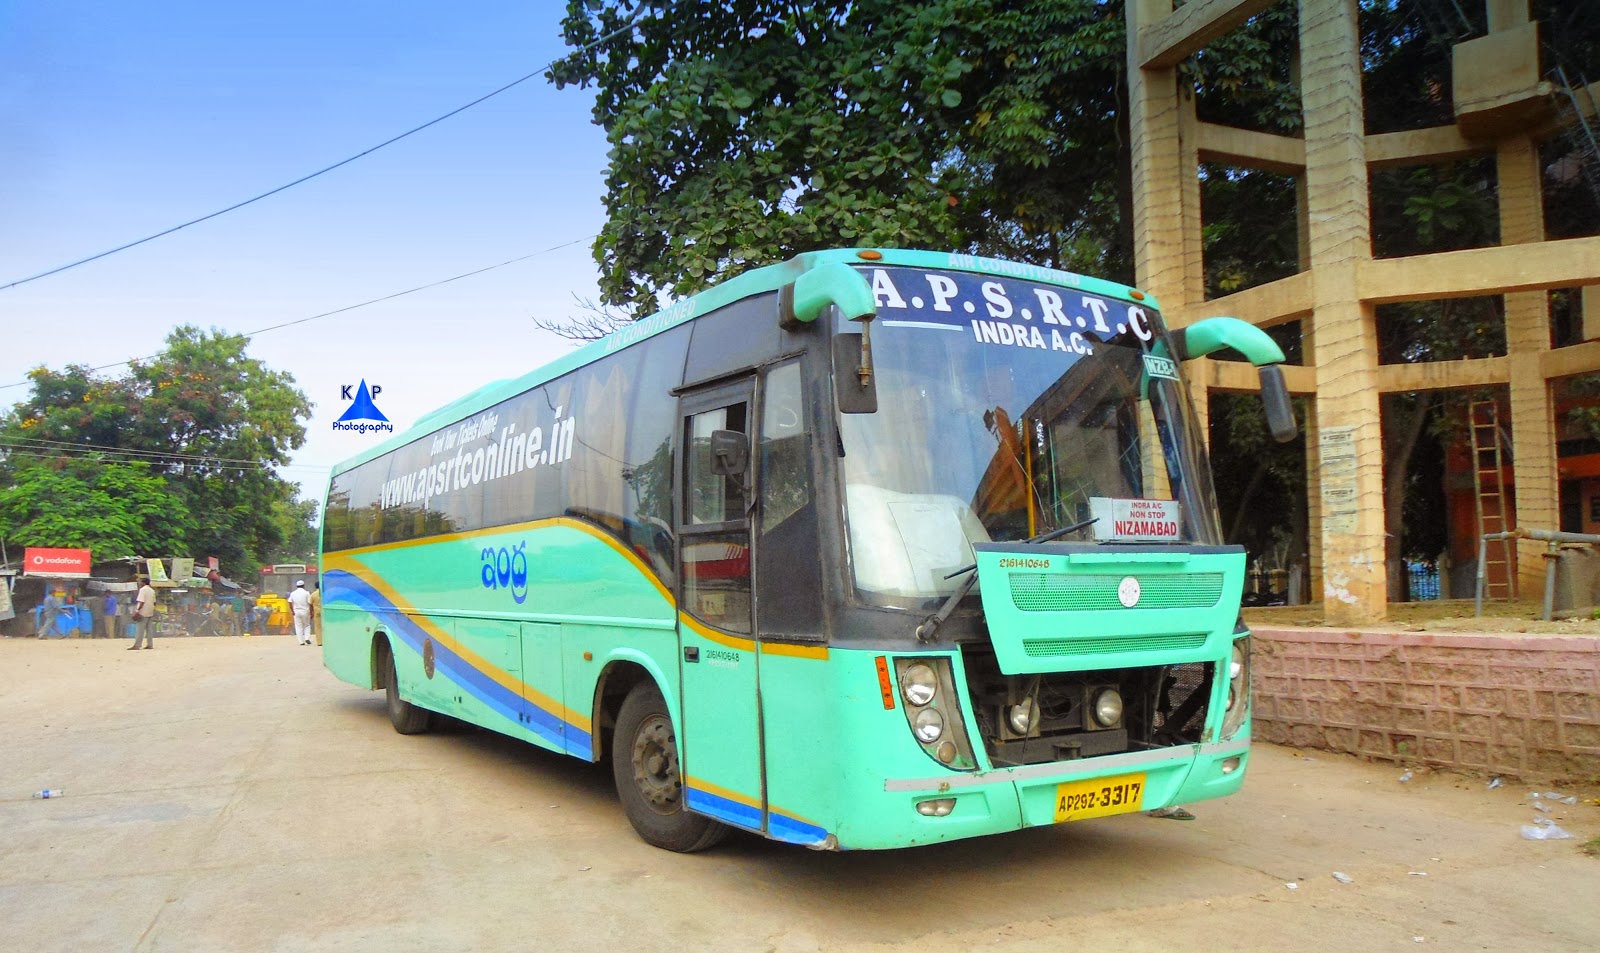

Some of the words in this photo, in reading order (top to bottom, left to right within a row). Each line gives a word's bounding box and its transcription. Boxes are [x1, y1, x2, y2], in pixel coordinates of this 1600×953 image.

[948, 253, 976, 269] AIR
[979, 256, 1081, 286] CONDITIONED
[605, 335, 621, 352] AIR
[624, 300, 695, 341] CONDITIONED
[971, 319, 1047, 351] INDRA
[1051, 328, 1094, 356] A.C.
[381, 405, 576, 510] www.apsrtconline.in
[1130, 511, 1146, 519] NON
[1147, 511, 1166, 519] STOP
[1115, 520, 1177, 536] NIZAMABAD
[45, 557, 82, 565] vodafone
[481, 539, 528, 605] ఇంద్ర
[999, 558, 1050, 568] 2161410648
[706, 649, 740, 662] 2161410648
